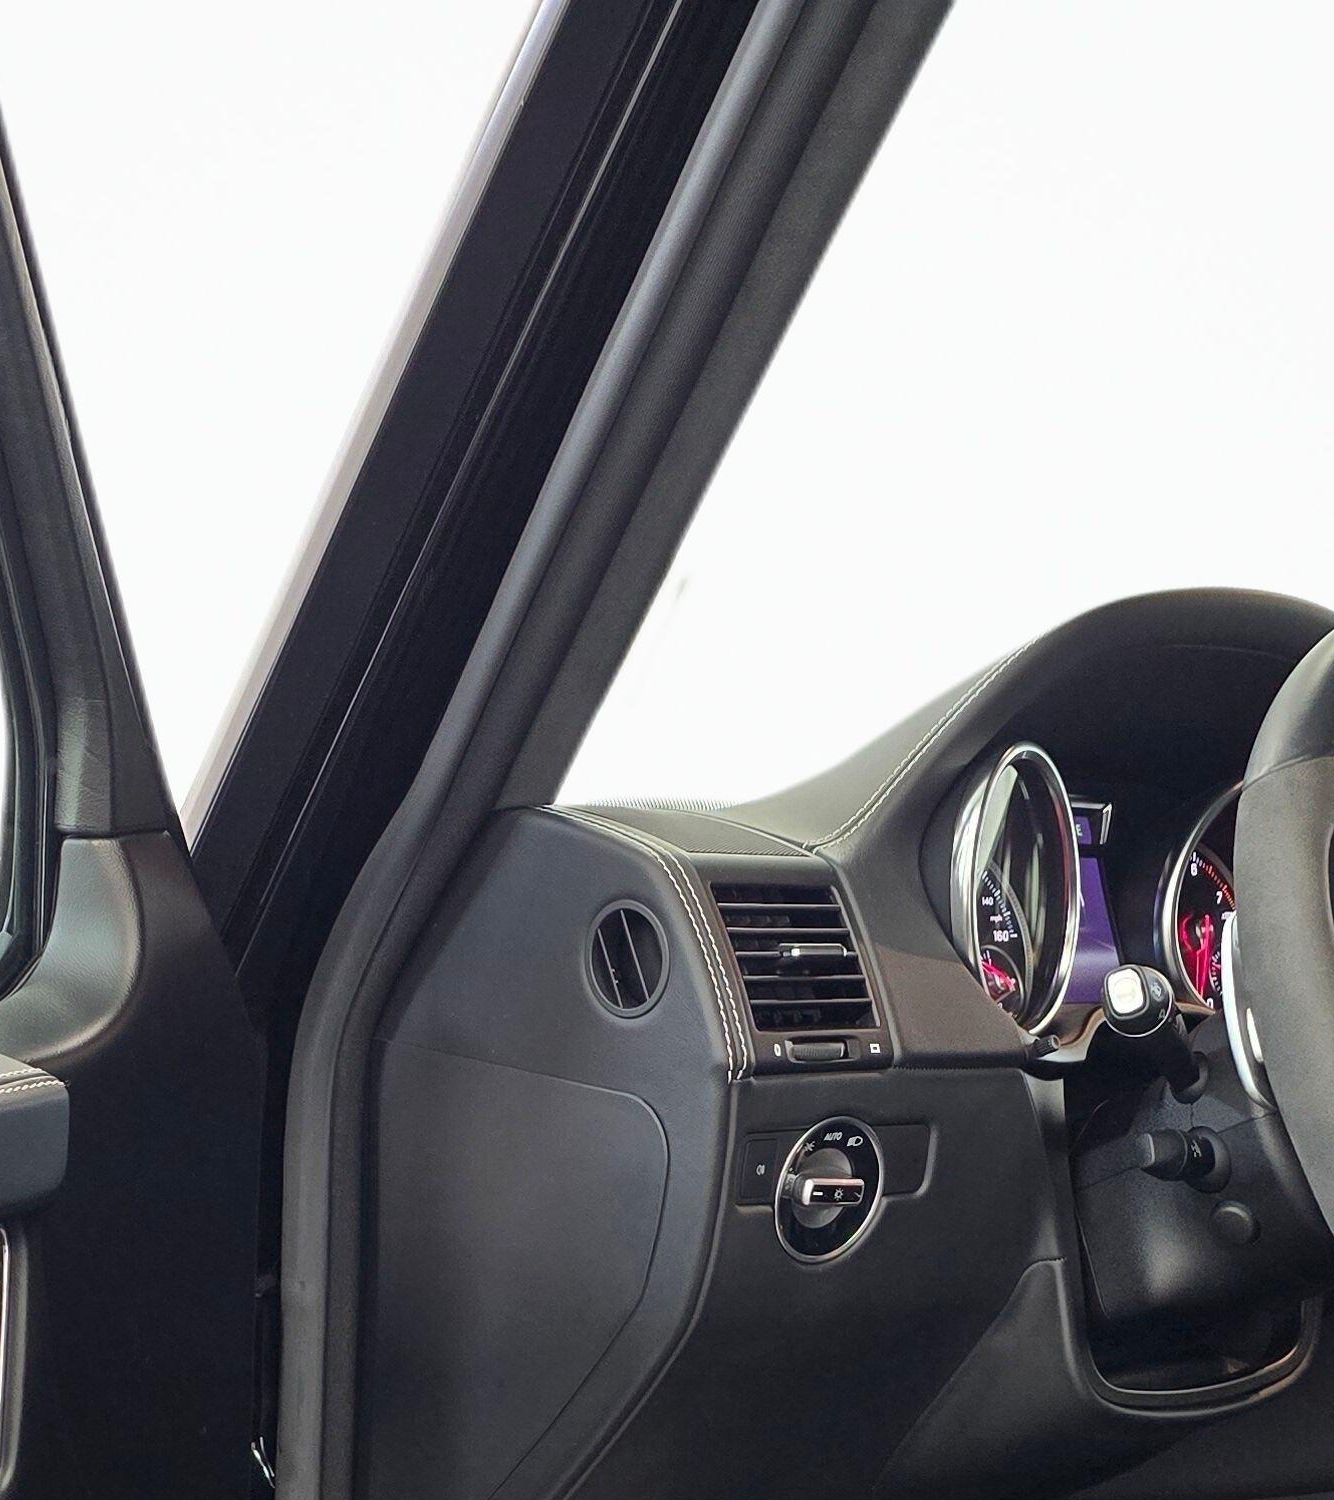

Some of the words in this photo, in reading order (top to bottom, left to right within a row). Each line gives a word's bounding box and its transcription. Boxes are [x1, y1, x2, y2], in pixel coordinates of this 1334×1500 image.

[1190, 863, 1198, 877] 6
[981, 896, 994, 906] 140
[1216, 891, 1223, 905] 7
[993, 930, 1009, 942] 160
[823, 1131, 843, 1141] AUTO
